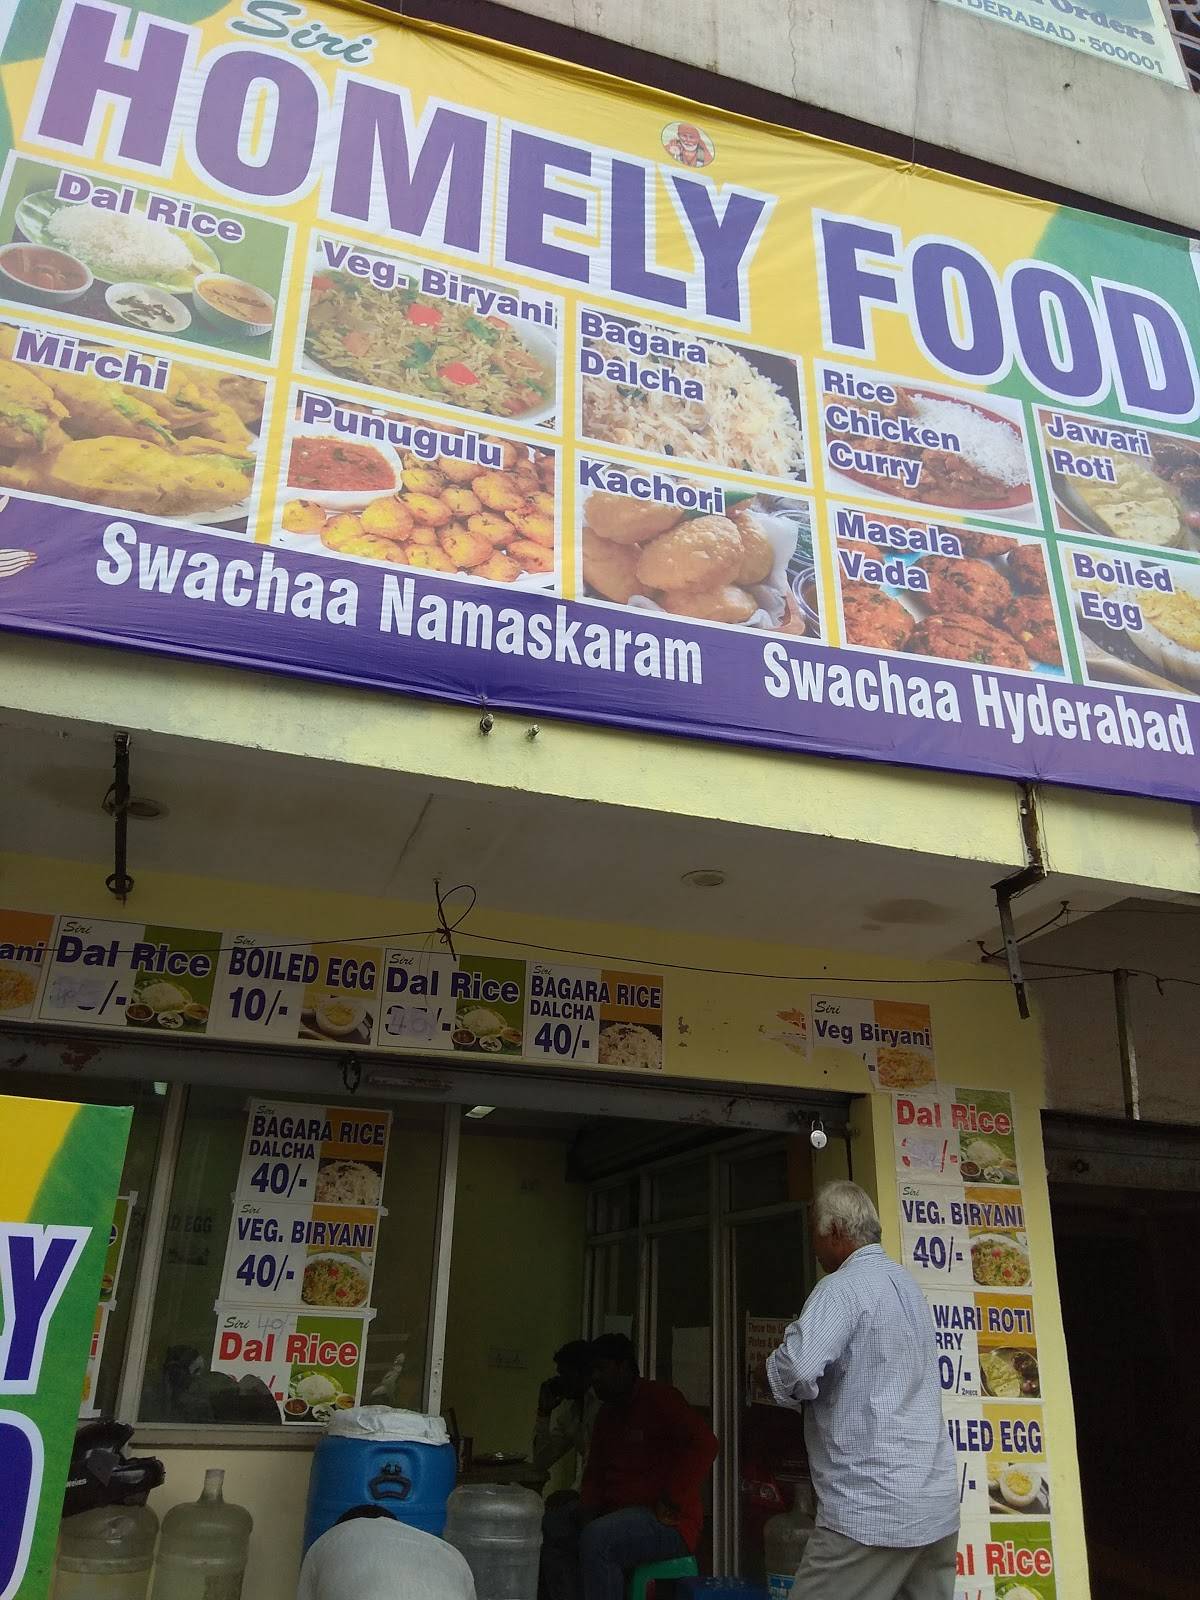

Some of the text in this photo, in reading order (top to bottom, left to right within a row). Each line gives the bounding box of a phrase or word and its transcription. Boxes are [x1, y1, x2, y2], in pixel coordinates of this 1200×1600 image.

[231, 1, 370, 64] Siri
[37, 2, 1196, 416] HOMELY FOOD
[58, 172, 244, 241] Dal Rice
[322, 240, 555, 327] Veg. Biryani
[580, 311, 708, 366] Bagara
[15, 330, 171, 390] Mirchi
[579, 348, 705, 401] Dalcha
[823, 368, 895, 403] Rice
[302, 395, 503, 468] Punugulu
[825, 406, 961, 453] Chicken
[1047, 415, 1150, 456] Jawari
[828, 442, 921, 486] Curry
[1053, 450, 1116, 482] Roti
[578, 460, 725, 515] Kachori
[836, 510, 962, 558] Masala
[840, 551, 929, 591] Vada
[1072, 552, 1174, 593] Boiled
[1081, 592, 1143, 630] Egg
[96, 521, 1195, 755] Swachaa Namaskaram Swachaa Hyderabad
[56, 935, 211, 977] Dal Rice
[228, 946, 376, 991] BOILED EGG
[386, 967, 519, 1003] Dal Rice
[530, 976, 661, 1009] BAGARA RICE
[228, 986, 288, 1026] 10/-
[529, 999, 595, 1021] DALCHA
[814, 1000, 841, 1015] Siri
[534, 1022, 590, 1059] 40/-
[814, 1019, 853, 1044] Veg
[860, 1022, 931, 1048] Biryani
[251, 1115, 385, 1146] BAGARA RICE
[896, 1099, 1012, 1134] Dal Rice
[248, 1139, 316, 1160] DALCHA
[250, 1162, 308, 1198] 40/-
[902, 1186, 920, 1197] Siri
[237, 1217, 375, 1248] VEG. BIRYANI
[902, 1199, 1024, 1228] VEG. BIRYANI
[236, 1254, 295, 1292] 40/-
[913, 1235, 963, 1273] 40/-
[223, 1316, 250, 1329] Siri
[988, 1307, 1032, 1333] ROTI
[218, 1331, 358, 1366] Dal Rice
[999, 1420, 1042, 1453] EGG
[985, 1542, 1051, 1576] Rice
